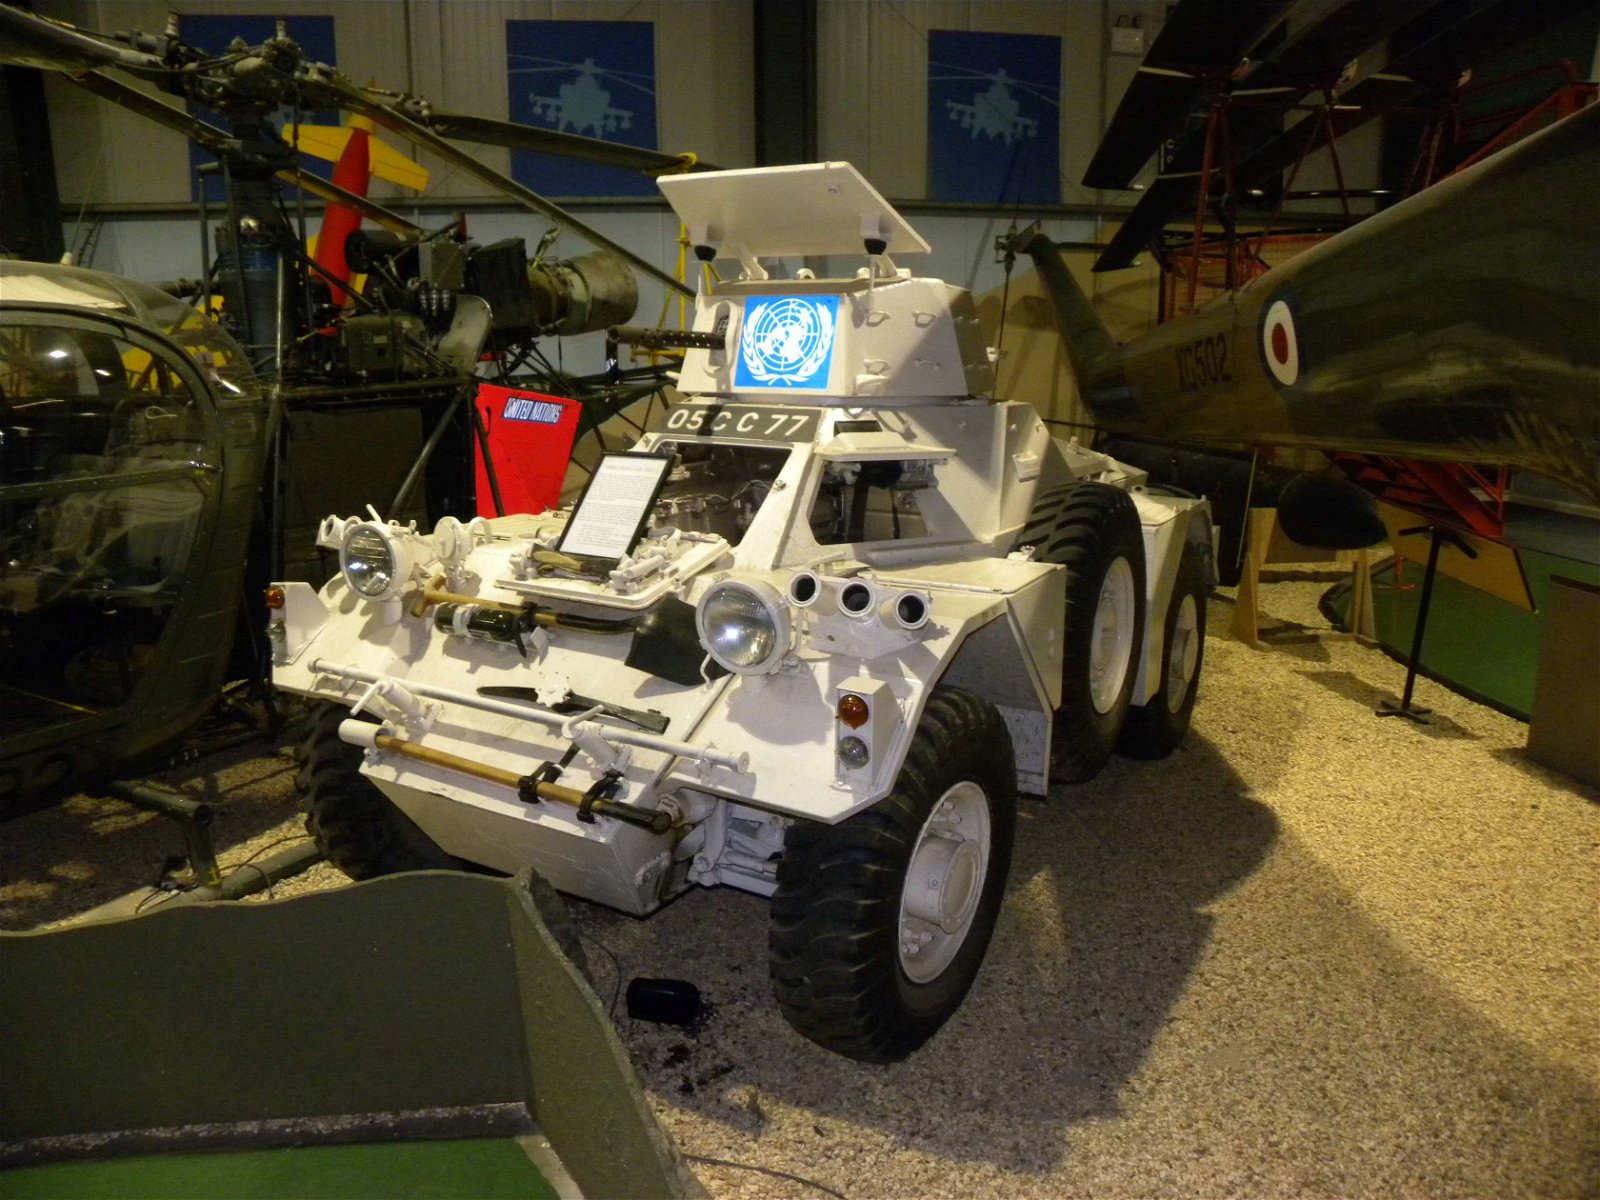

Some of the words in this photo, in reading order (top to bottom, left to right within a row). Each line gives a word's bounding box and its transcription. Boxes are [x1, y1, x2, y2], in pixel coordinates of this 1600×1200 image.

[503, 397, 534, 420] UNITED
[529, 401, 563, 424] NATIONS
[667, 409, 707, 430] 05
[764, 414, 809, 436] 77
